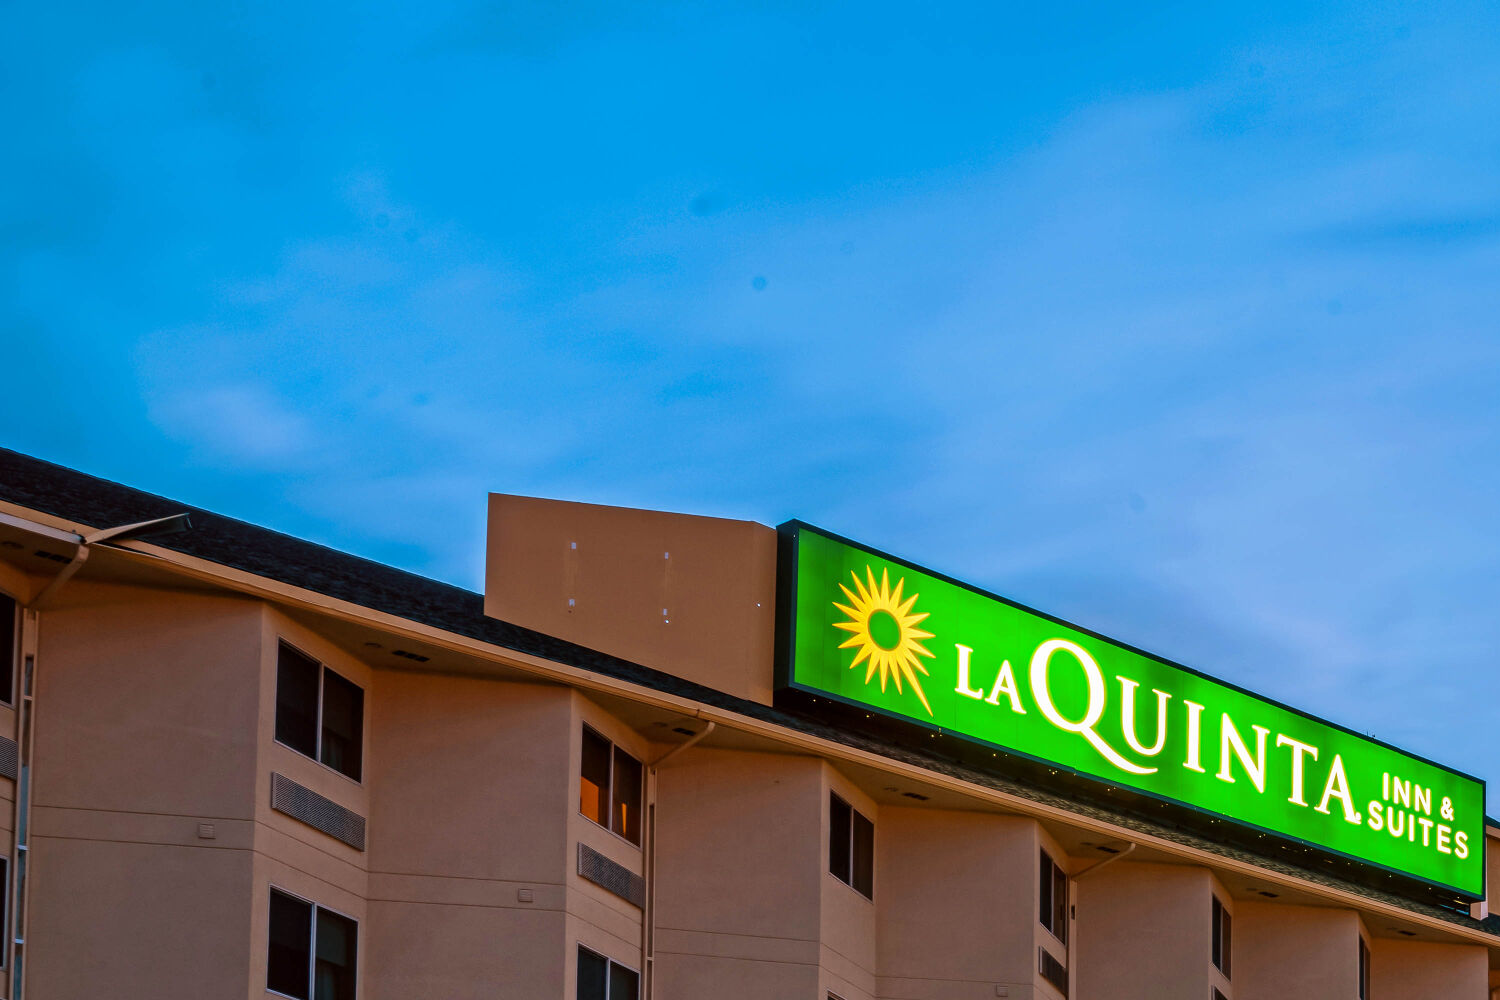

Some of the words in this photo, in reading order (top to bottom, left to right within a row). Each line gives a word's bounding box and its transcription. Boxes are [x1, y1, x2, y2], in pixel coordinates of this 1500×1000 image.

[953, 642, 1027, 715] LA
[1029, 637, 1362, 826] QUINTA
[1382, 771, 1432, 817] INN
[1439, 795, 1455, 823] &
[1366, 799, 1469, 860] SUITES
